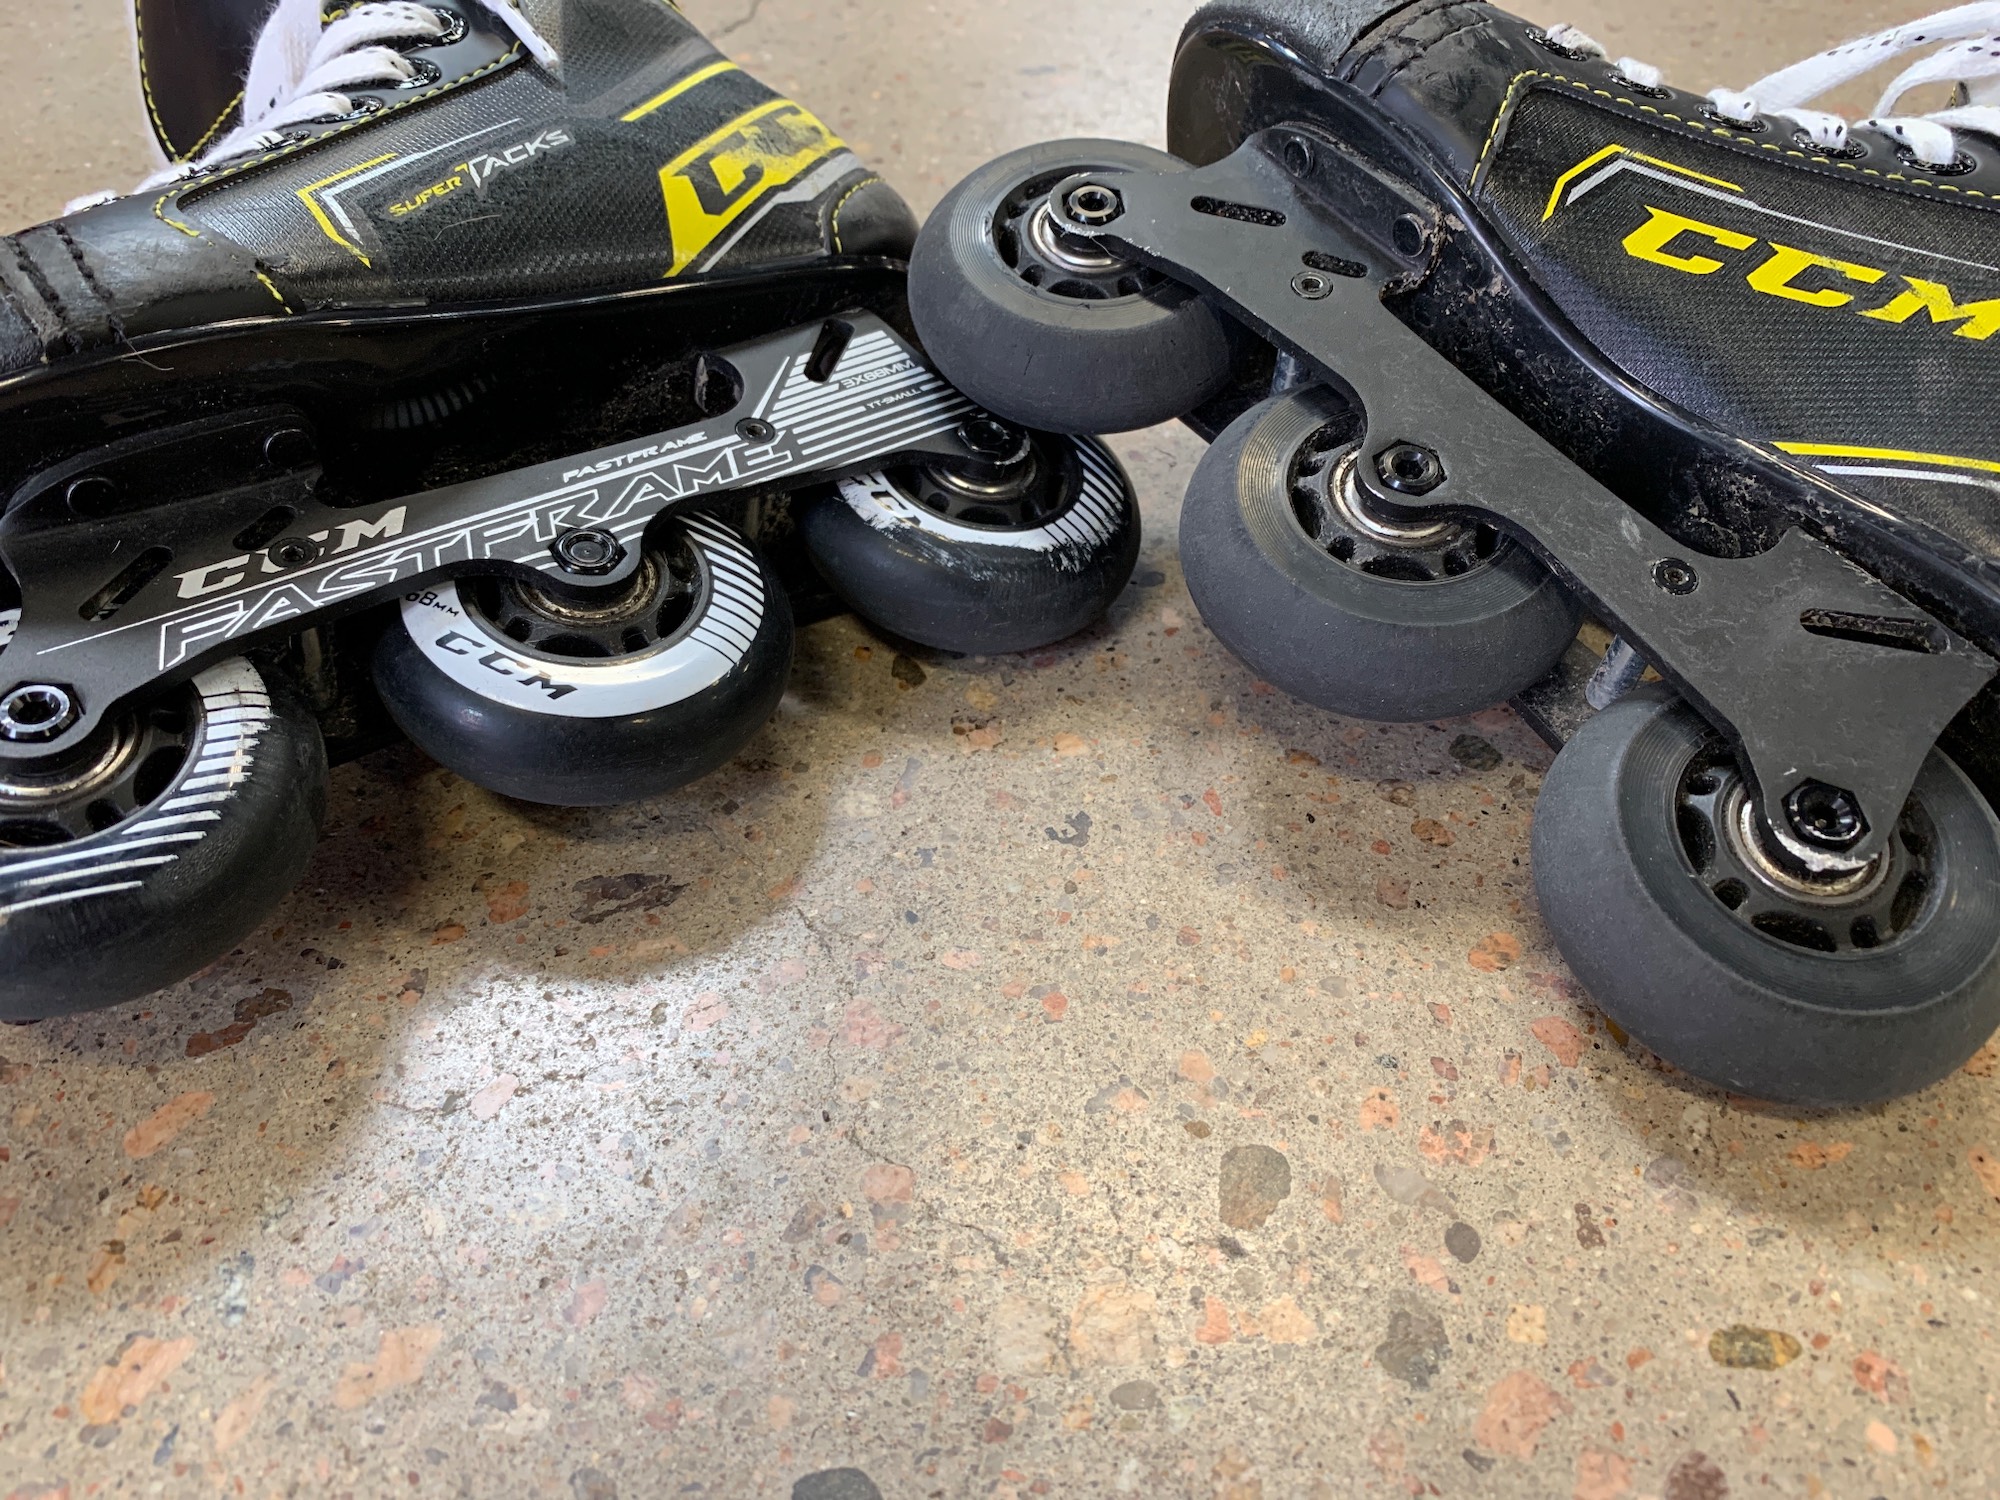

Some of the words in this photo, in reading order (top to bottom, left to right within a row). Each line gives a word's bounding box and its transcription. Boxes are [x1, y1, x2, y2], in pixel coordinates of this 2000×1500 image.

[1621, 204, 2000, 341] CCM
[840, 359, 916, 389] 3X68MM
[866, 388, 923, 410] YT-SMALL
[562, 431, 708, 483] FASTFRAME
[158, 430, 794, 671] FASTFRAME
[434, 630, 579, 701] CCM
